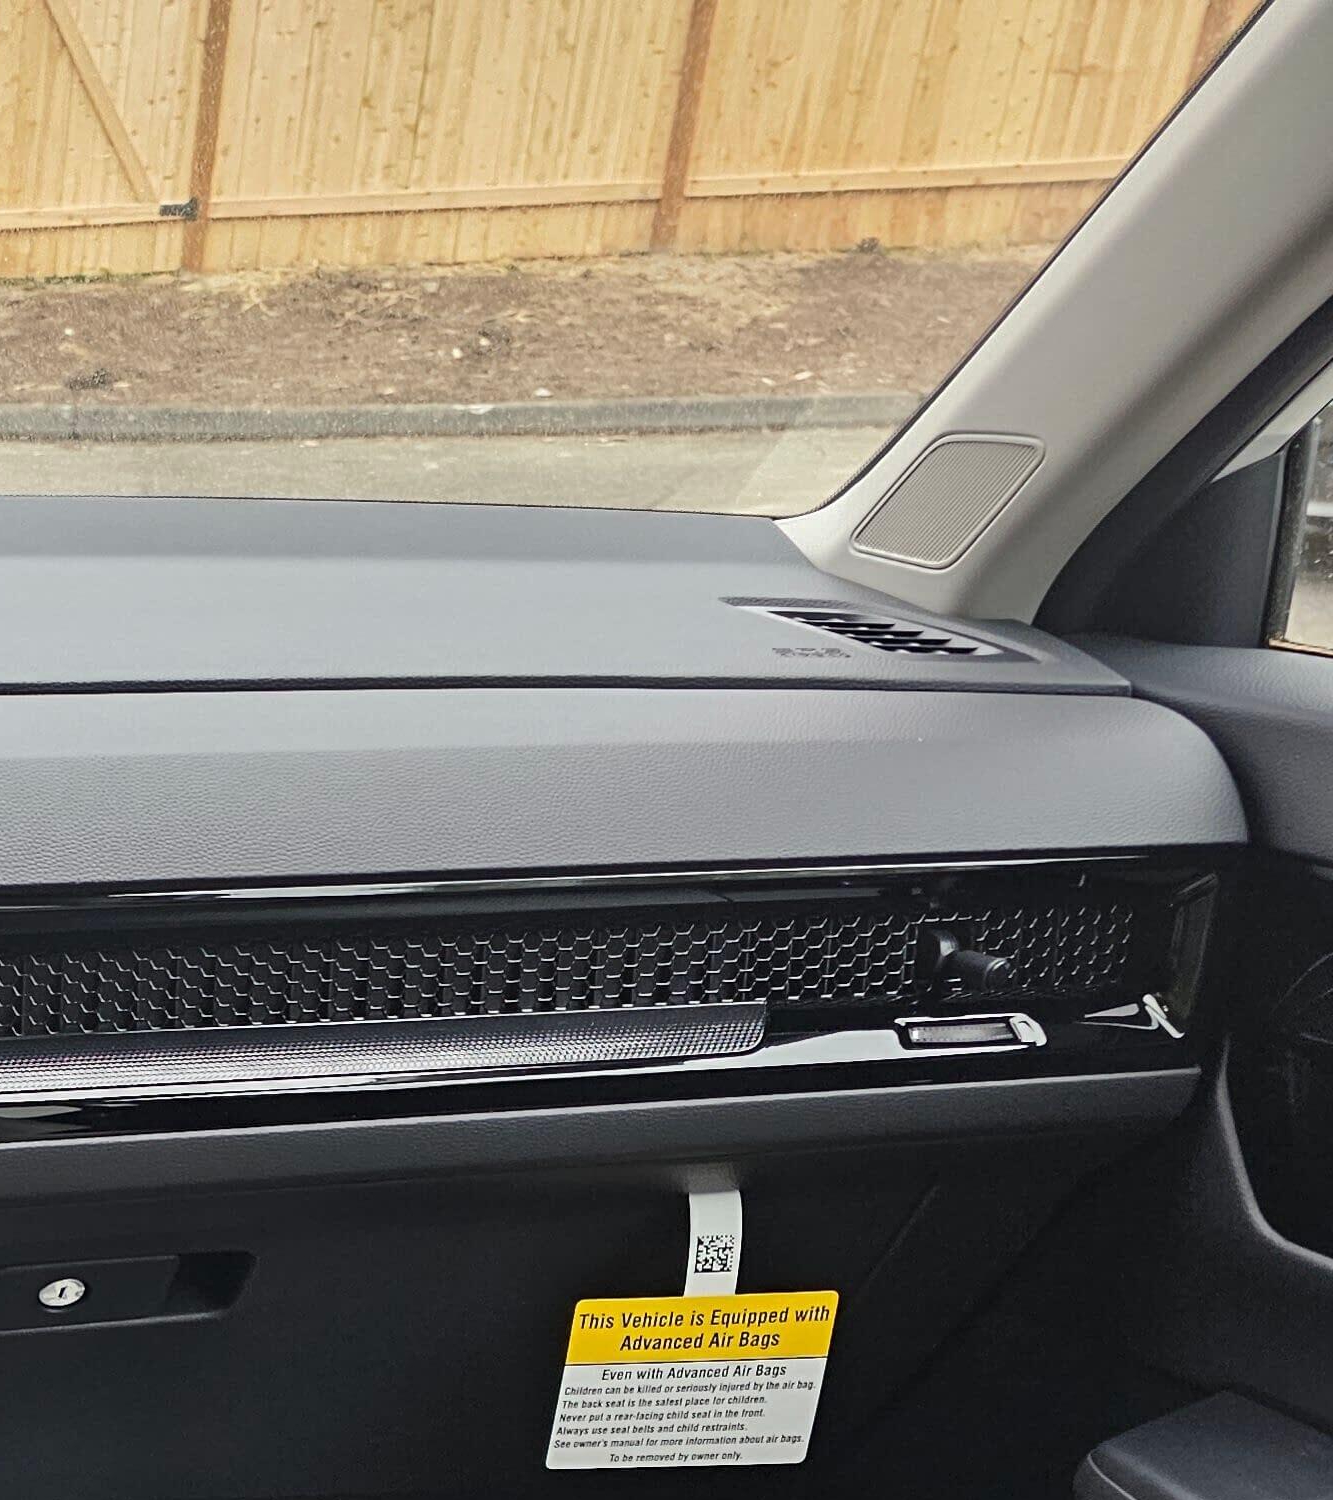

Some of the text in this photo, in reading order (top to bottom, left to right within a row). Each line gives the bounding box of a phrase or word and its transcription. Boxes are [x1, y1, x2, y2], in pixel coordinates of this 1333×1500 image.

[579, 1305, 830, 1329] This Vehicle is Equipped with
[620, 1331, 781, 1351] Advanced Air Bags
[601, 1364, 787, 1381] Even with Advanced Air Bags
[564, 1386, 603, 1396] Children
[605, 1386, 621, 1395] can
[623, 1385, 635, 1394] be
[637, 1385, 663, 1394] killed
[676, 1383, 717, 1393] seriously
[719, 1382, 751, 1393] injured
[753, 1382, 764, 1392] by
[766, 1381, 780, 1390] the
[782, 1381, 795, 1390] air
[562, 1400, 578, 1409] The
[581, 1400, 603, 1408] back
[605, 1399, 625, 1408] seat
[628, 1399, 636, 1408] is
[638, 1399, 653, 1407] the
[655, 1398, 683, 1407] safest
[685, 1396, 710, 1407] place
[713, 1397, 726, 1405] for
[559, 1413, 587, 1422] Never
[588, 1413, 604, 1423] put
[614, 1411, 664, 1421] rear-facing
[666, 1410, 689, 1419] child
[691, 1410, 711, 1419] seat
[714, 1409, 722, 1418] in
[725, 1409, 739, 1418] the
[556, 1427, 589, 1436] Always
[610, 1426, 630, 1434] seat
[632, 1425, 655, 1434] belts
[657, 1424, 674, 1433] and
[677, 1424, 699, 1432] child
[554, 1440, 571, 1448] See
[573, 1439, 608, 1448] owner's
[610, 1438, 644, 1447] manual
[645, 1438, 657, 1446] for
[685, 1436, 736, 1445] information
[739, 1435, 764, 1444] about
[766, 1435, 779, 1444] air
[610, 1453, 619, 1462] To
[622, 1453, 633, 1462] be
[636, 1452, 676, 1461] removed
[678, 1452, 688, 1462] by
[691, 1452, 719, 1460] owner
